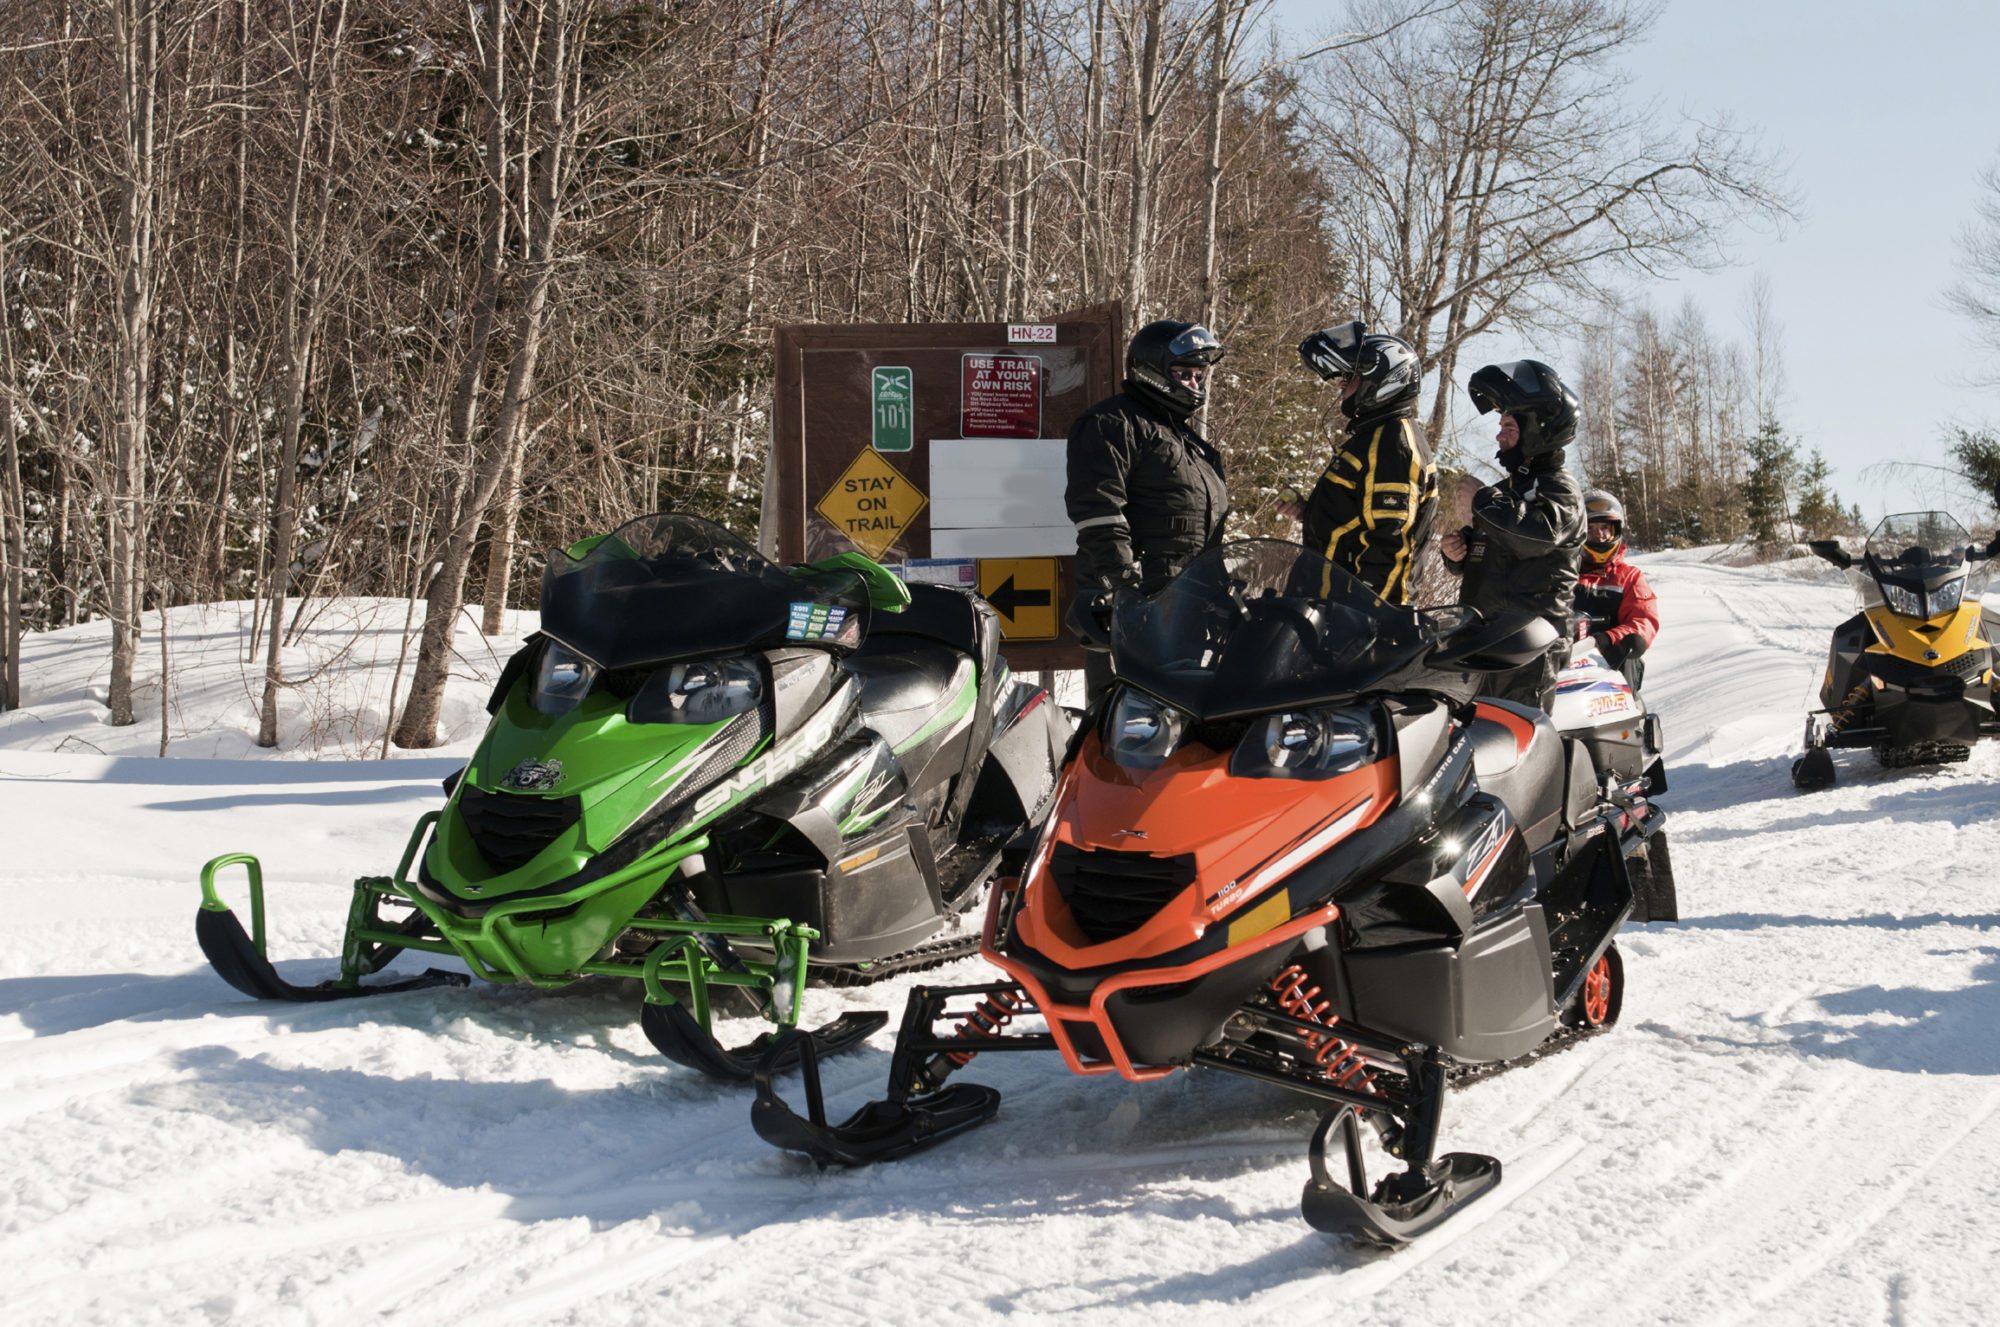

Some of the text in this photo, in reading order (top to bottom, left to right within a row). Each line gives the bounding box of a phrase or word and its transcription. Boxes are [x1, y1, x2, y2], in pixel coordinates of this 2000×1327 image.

[1011, 327, 1053, 340] HN-22
[970, 360, 1034, 370] USE TRAIL
[976, 370, 1030, 380] AT YOUR
[972, 380, 1032, 391] OWN RISK
[878, 402, 906, 429] 101
[844, 476, 895, 492] STAY
[857, 496, 887, 511] ON
[846, 516, 900, 532] TRAIL
[1452, 736, 1466, 754] CAT
[1466, 808, 1506, 880] Z1
[1217, 880, 1236, 898] 1100
[1210, 888, 1242, 916] TURBO
